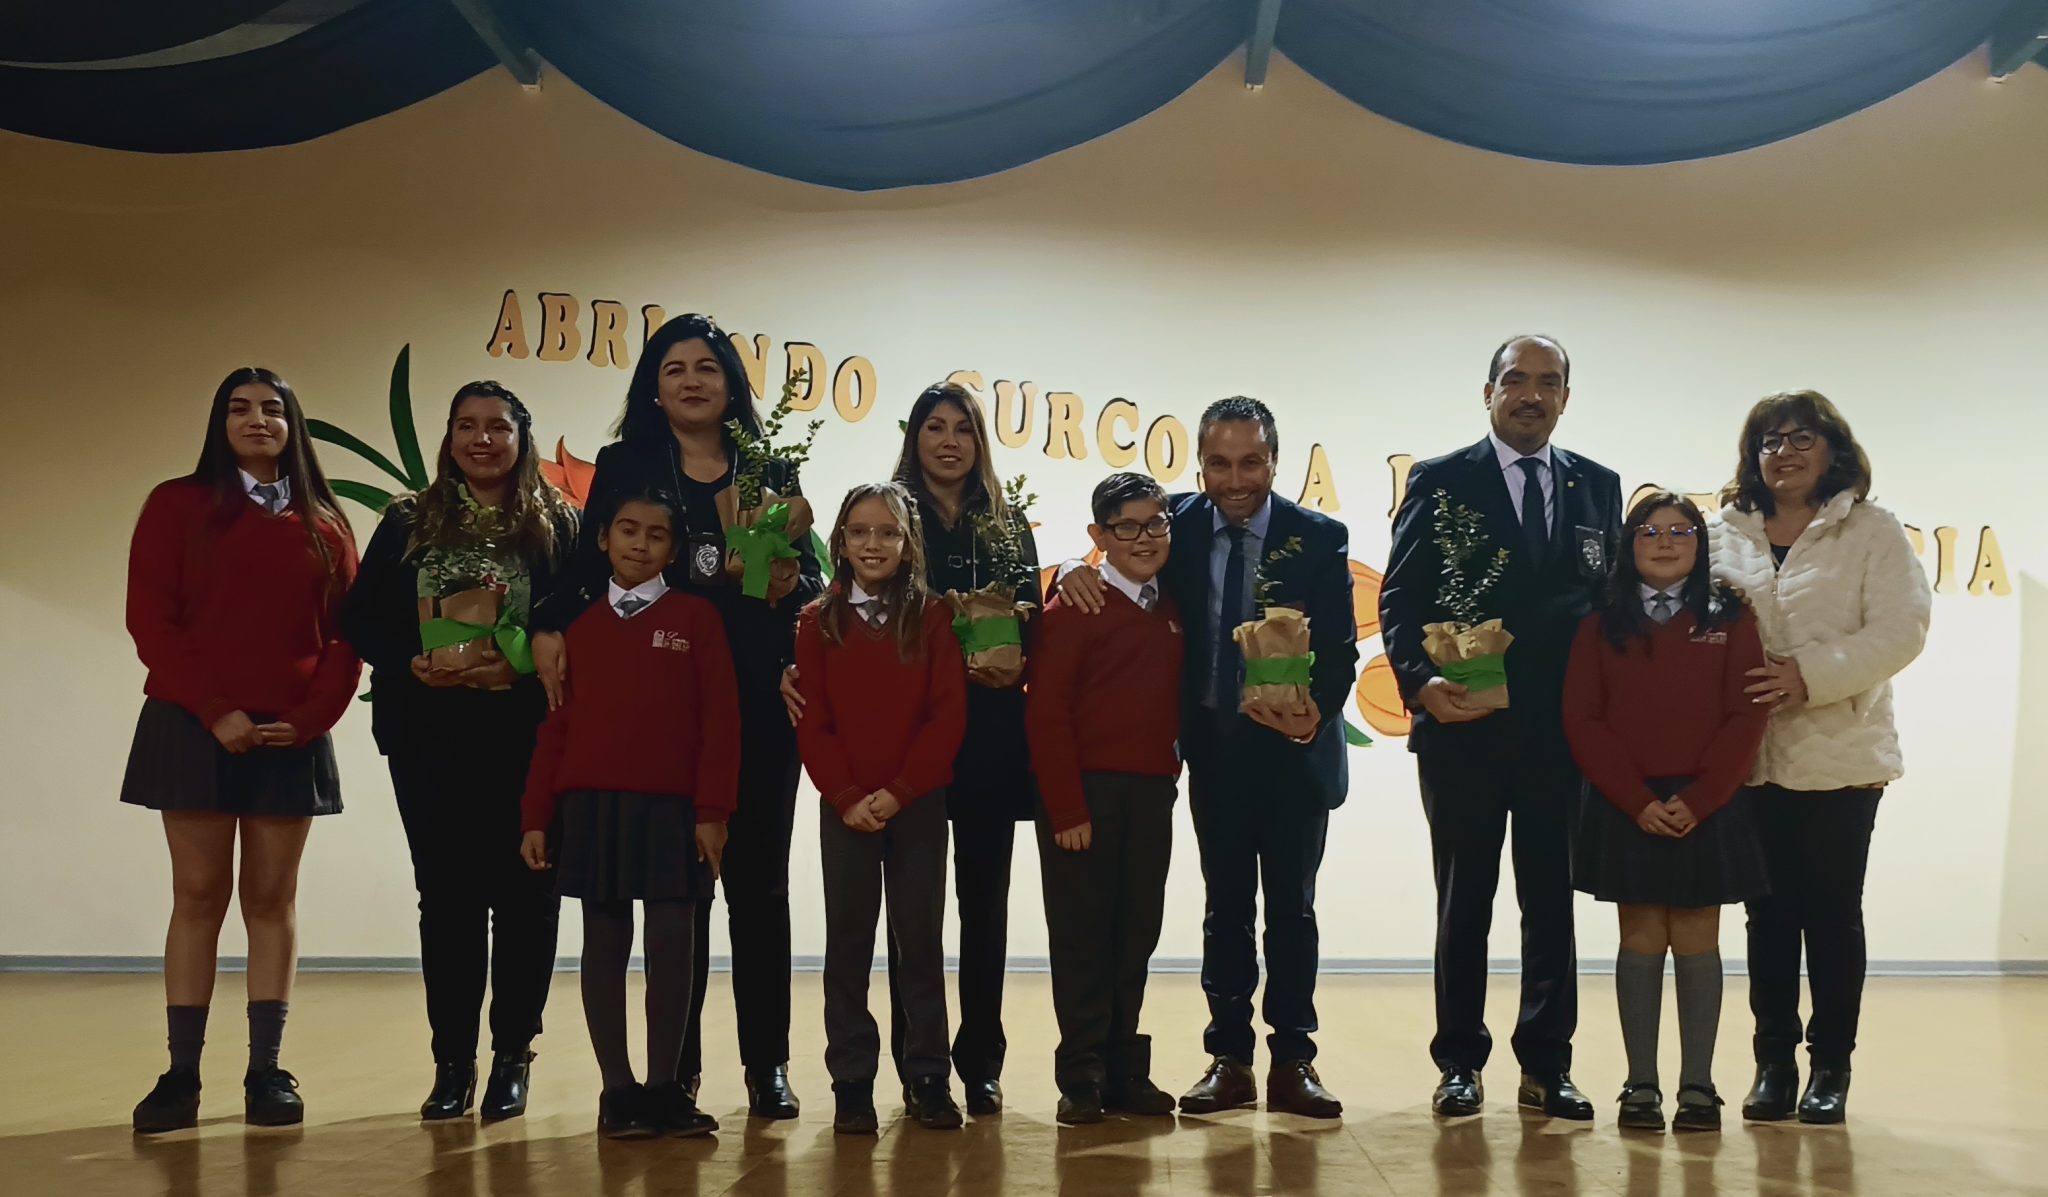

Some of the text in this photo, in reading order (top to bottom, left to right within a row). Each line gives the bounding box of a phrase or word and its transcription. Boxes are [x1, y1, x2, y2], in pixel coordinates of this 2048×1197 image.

[486, 289, 877, 422] ABRNDO
[945, 369, 1206, 494] URCO
[1297, 443, 1341, 513] A
